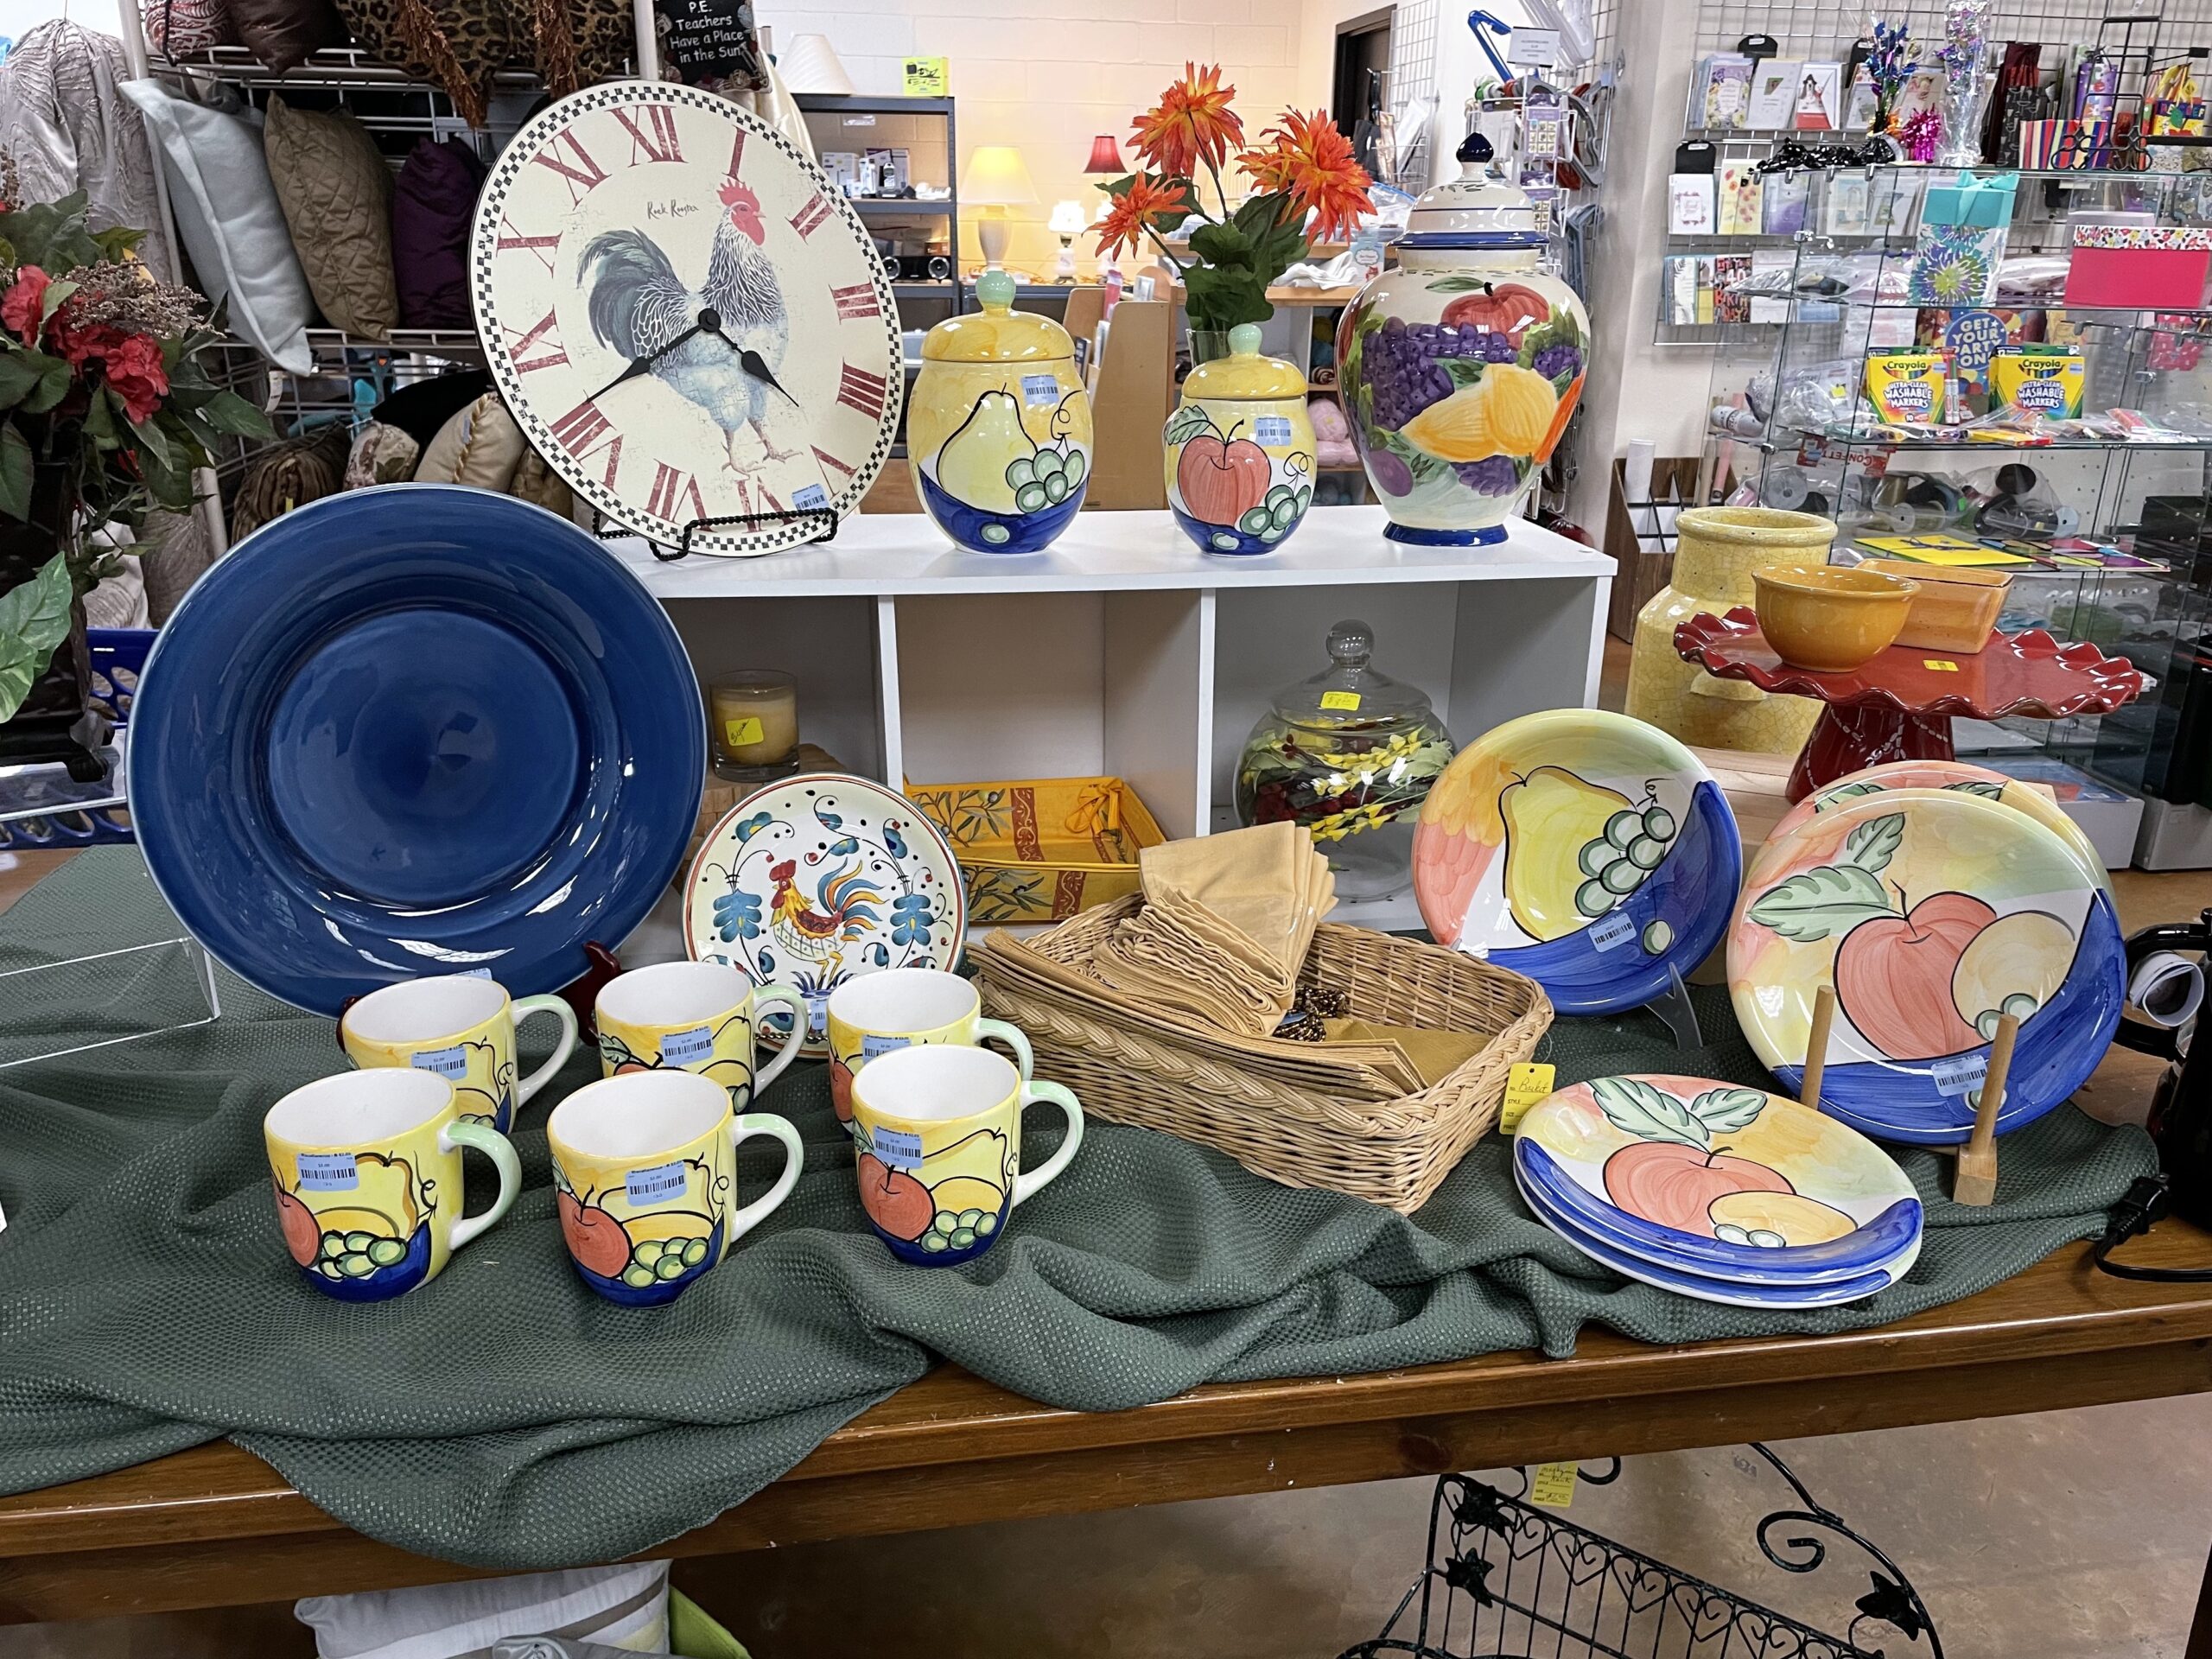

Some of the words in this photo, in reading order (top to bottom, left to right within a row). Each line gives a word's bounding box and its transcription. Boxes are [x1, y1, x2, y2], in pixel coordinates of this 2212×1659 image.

[689, 0, 712, 13] P.E.
[676, 16, 733, 31] Teachers
[670, 35, 700, 49] Have
[703, 35, 711, 43] a
[713, 30, 745, 42] Place
[679, 51, 691, 63] in
[693, 48, 715, 61] the
[605, 105, 689, 168] XII
[529, 124, 613, 211] XI
[496, 212, 563, 279] X
[1961, 318, 1990, 332] GET
[500, 303, 572, 382] IX
[1952, 328, 1999, 345] YOUR
[1887, 360, 1926, 371] Crayola
[2023, 359, 2061, 369] Crayola
[1889, 381, 1929, 391] ULTRA-CLEAN
[2018, 387, 2064, 399] WASHABLE
[1884, 389, 1933, 400] WASHABLE
[1891, 397, 1929, 409] MARKERS
[2023, 397, 2060, 408] MARKERS
[542, 389, 624, 496] VIII
